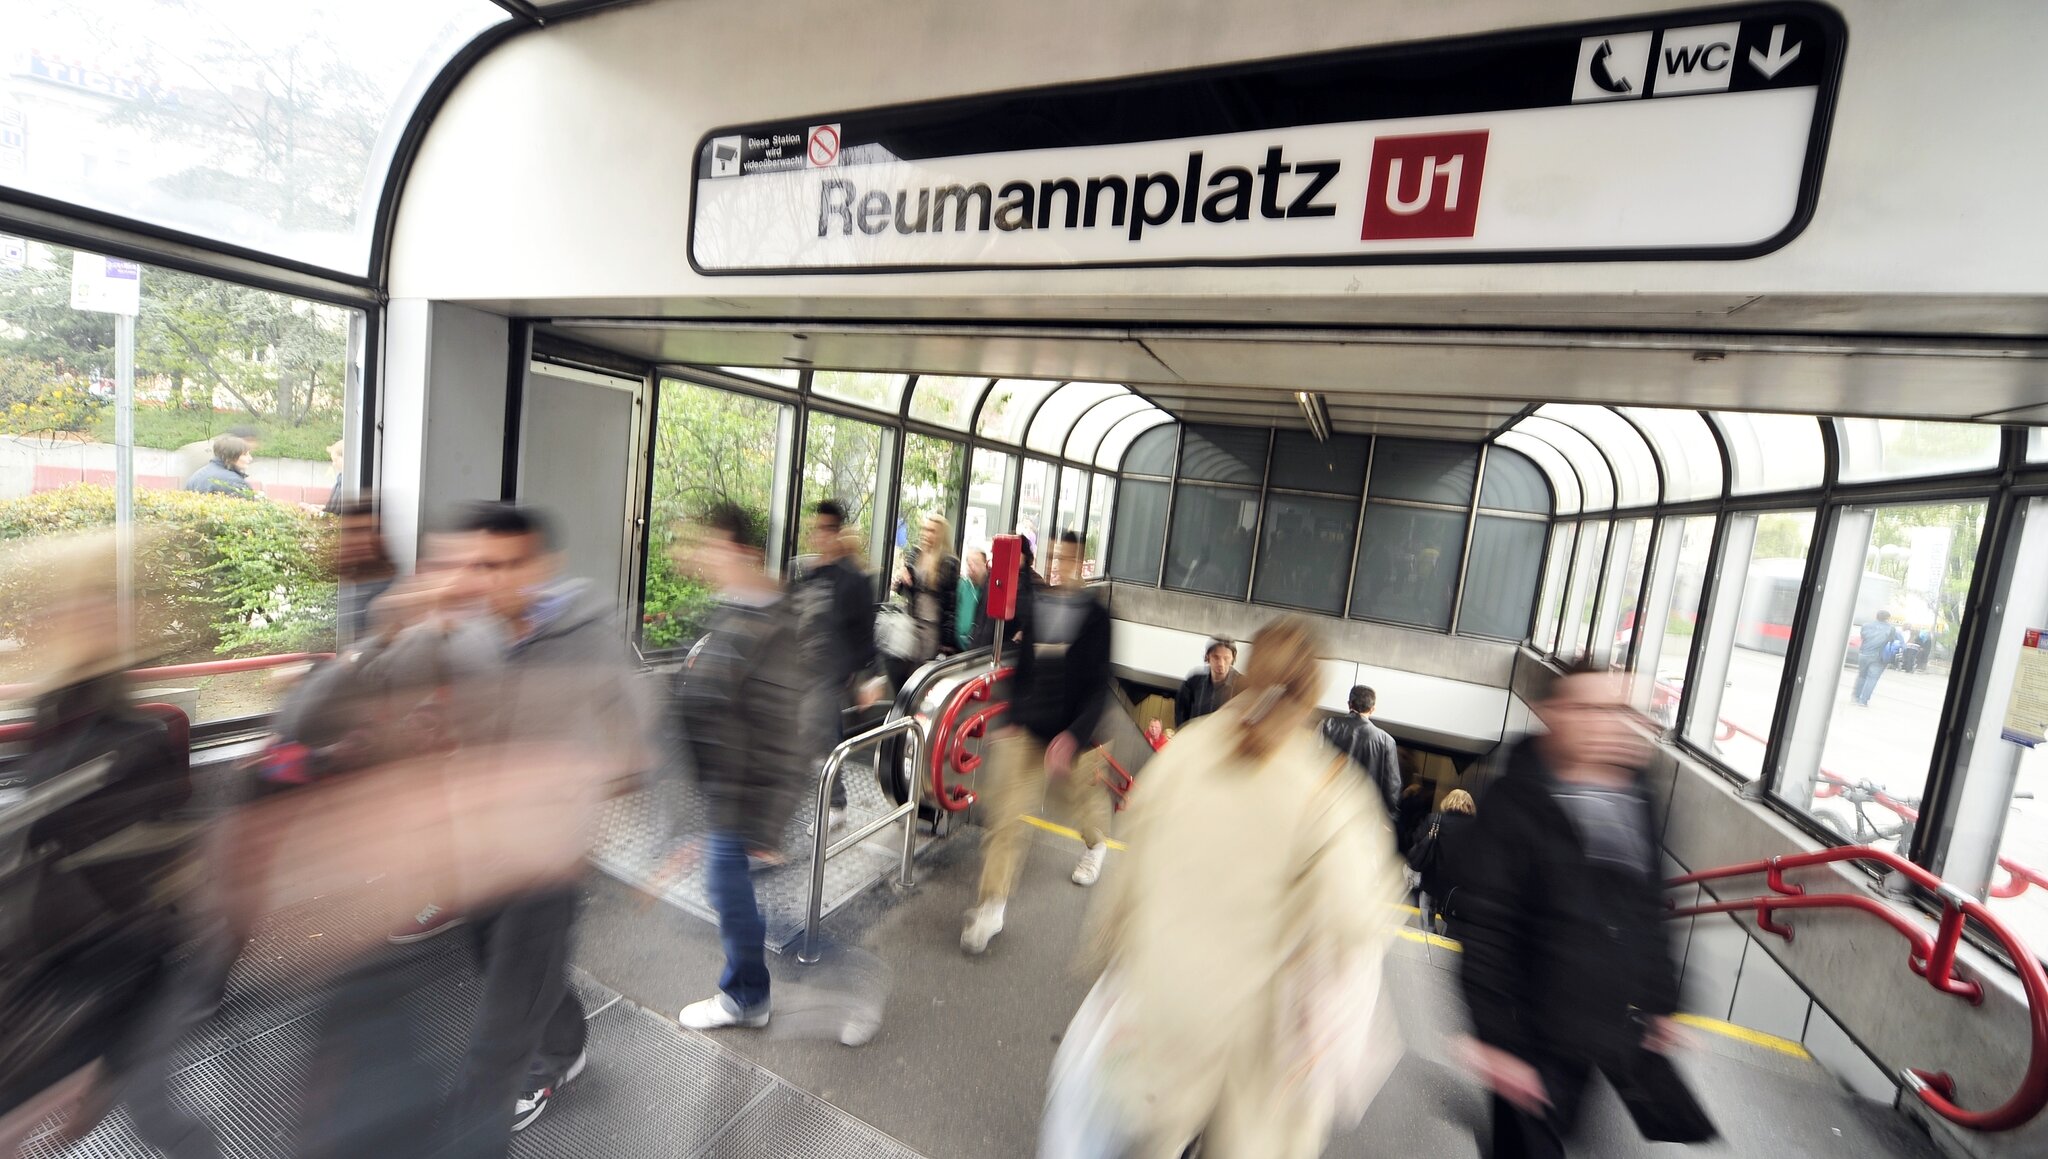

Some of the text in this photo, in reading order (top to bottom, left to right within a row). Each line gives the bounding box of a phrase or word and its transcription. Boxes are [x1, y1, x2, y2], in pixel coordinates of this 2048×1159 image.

[1664, 41, 1732, 79] WC
[748, 134, 801, 148] Diese Station
[765, 146, 782, 158] wird
[743, 155, 803, 172] videoüberwacht
[817, 145, 1465, 241] Reumannplatz U1
